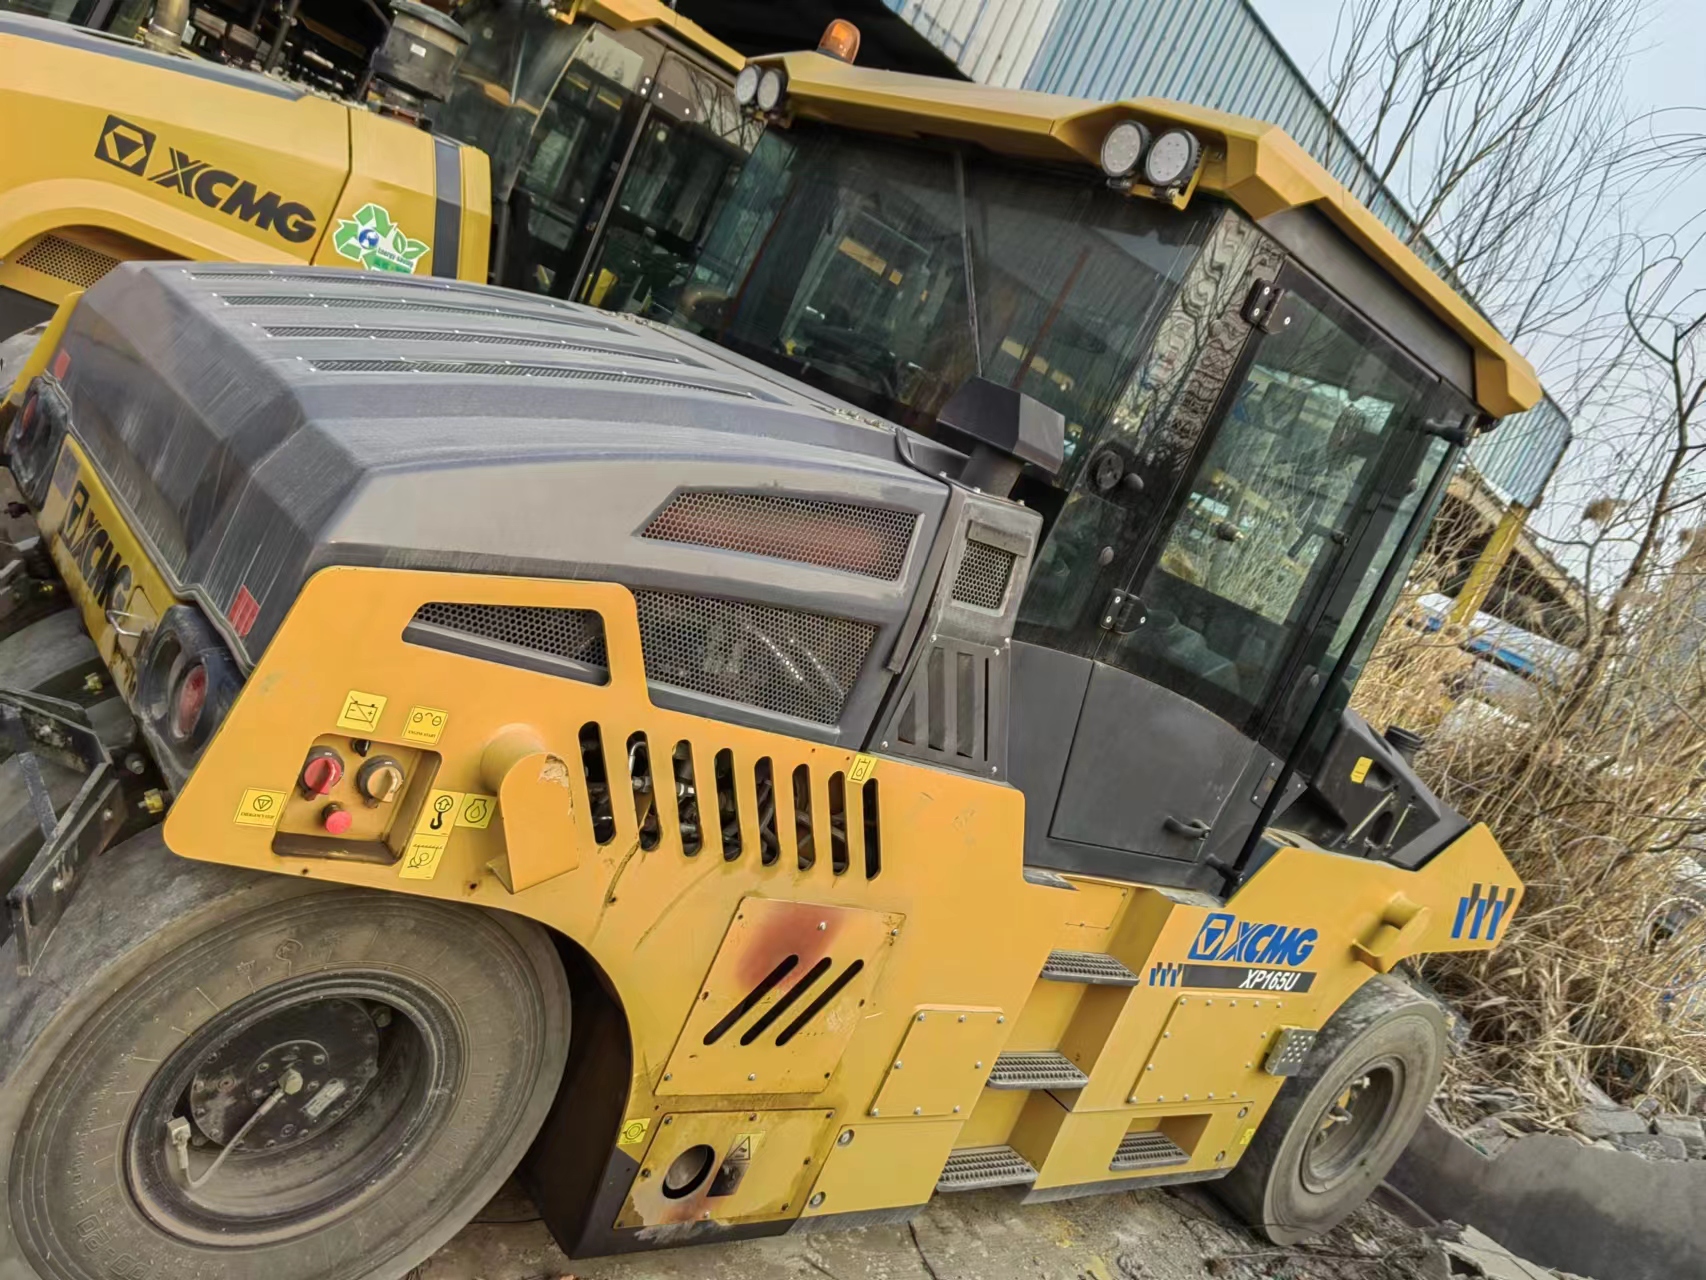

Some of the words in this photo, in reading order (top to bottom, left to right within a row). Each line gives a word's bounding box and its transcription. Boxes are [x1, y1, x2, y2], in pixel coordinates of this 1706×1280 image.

[147, 147, 316, 243] XCMG
[69, 508, 133, 624] XCMG
[1216, 921, 1318, 966] XCMG
[1238, 969, 1301, 991] XP165U
